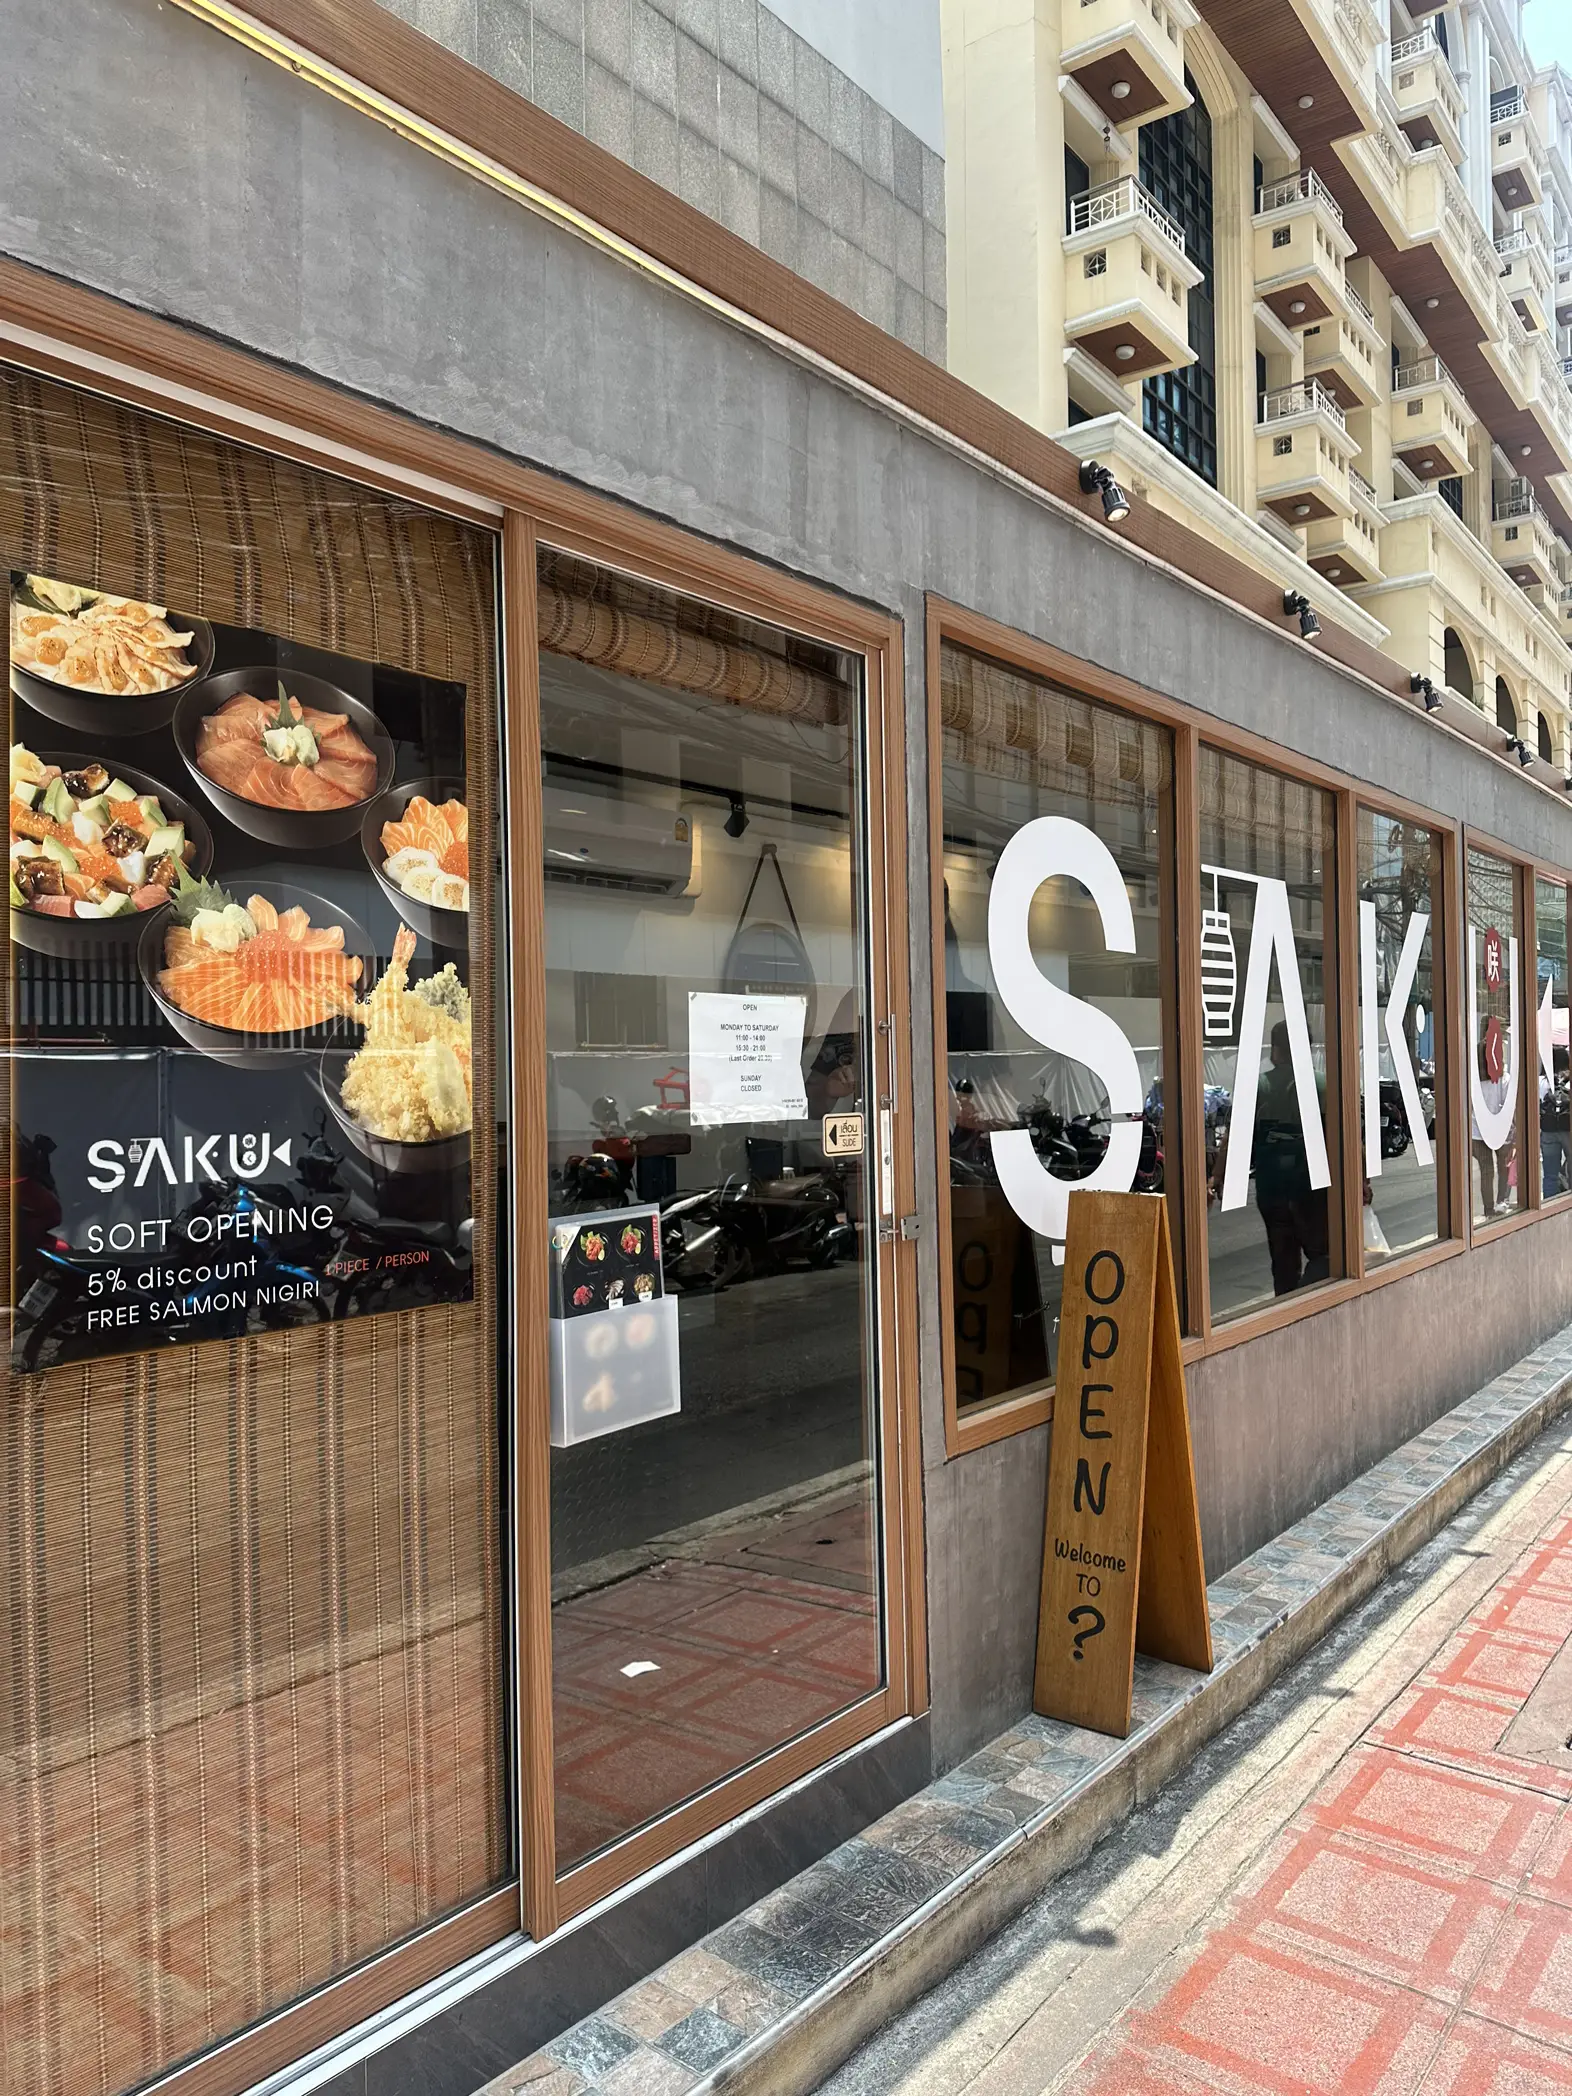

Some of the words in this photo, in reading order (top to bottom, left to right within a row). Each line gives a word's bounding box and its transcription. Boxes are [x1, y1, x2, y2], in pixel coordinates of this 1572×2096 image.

[742, 1003, 758, 1011] OPEN
[720, 1023, 743, 1031] MONDAY
[752, 1024, 779, 1032] SATURDAY
[728, 1054, 742, 1063] (Last
[742, 1054, 757, 1062] Order
[740, 1074, 762, 1082] SUNDAY
[740, 1084, 762, 1092] CLOSED
[840, 1119, 858, 1134] เลื่อน
[87, 1132, 271, 1193] SAKU
[87, 1219, 172, 1254] SOFT
[187, 1204, 334, 1243] OPENING
[88, 1267, 127, 1296] 5%
[137, 1255, 258, 1290] discount
[325, 1263, 332, 1276] 1
[335, 1258, 370, 1274] PIECE
[87, 1304, 140, 1330] FREE
[150, 1290, 247, 1321] SALMON
[256, 1280, 319, 1306] NIGIRI
[1054, 1538, 1127, 1572] Welcome
[1075, 1573, 1101, 1597] TO
